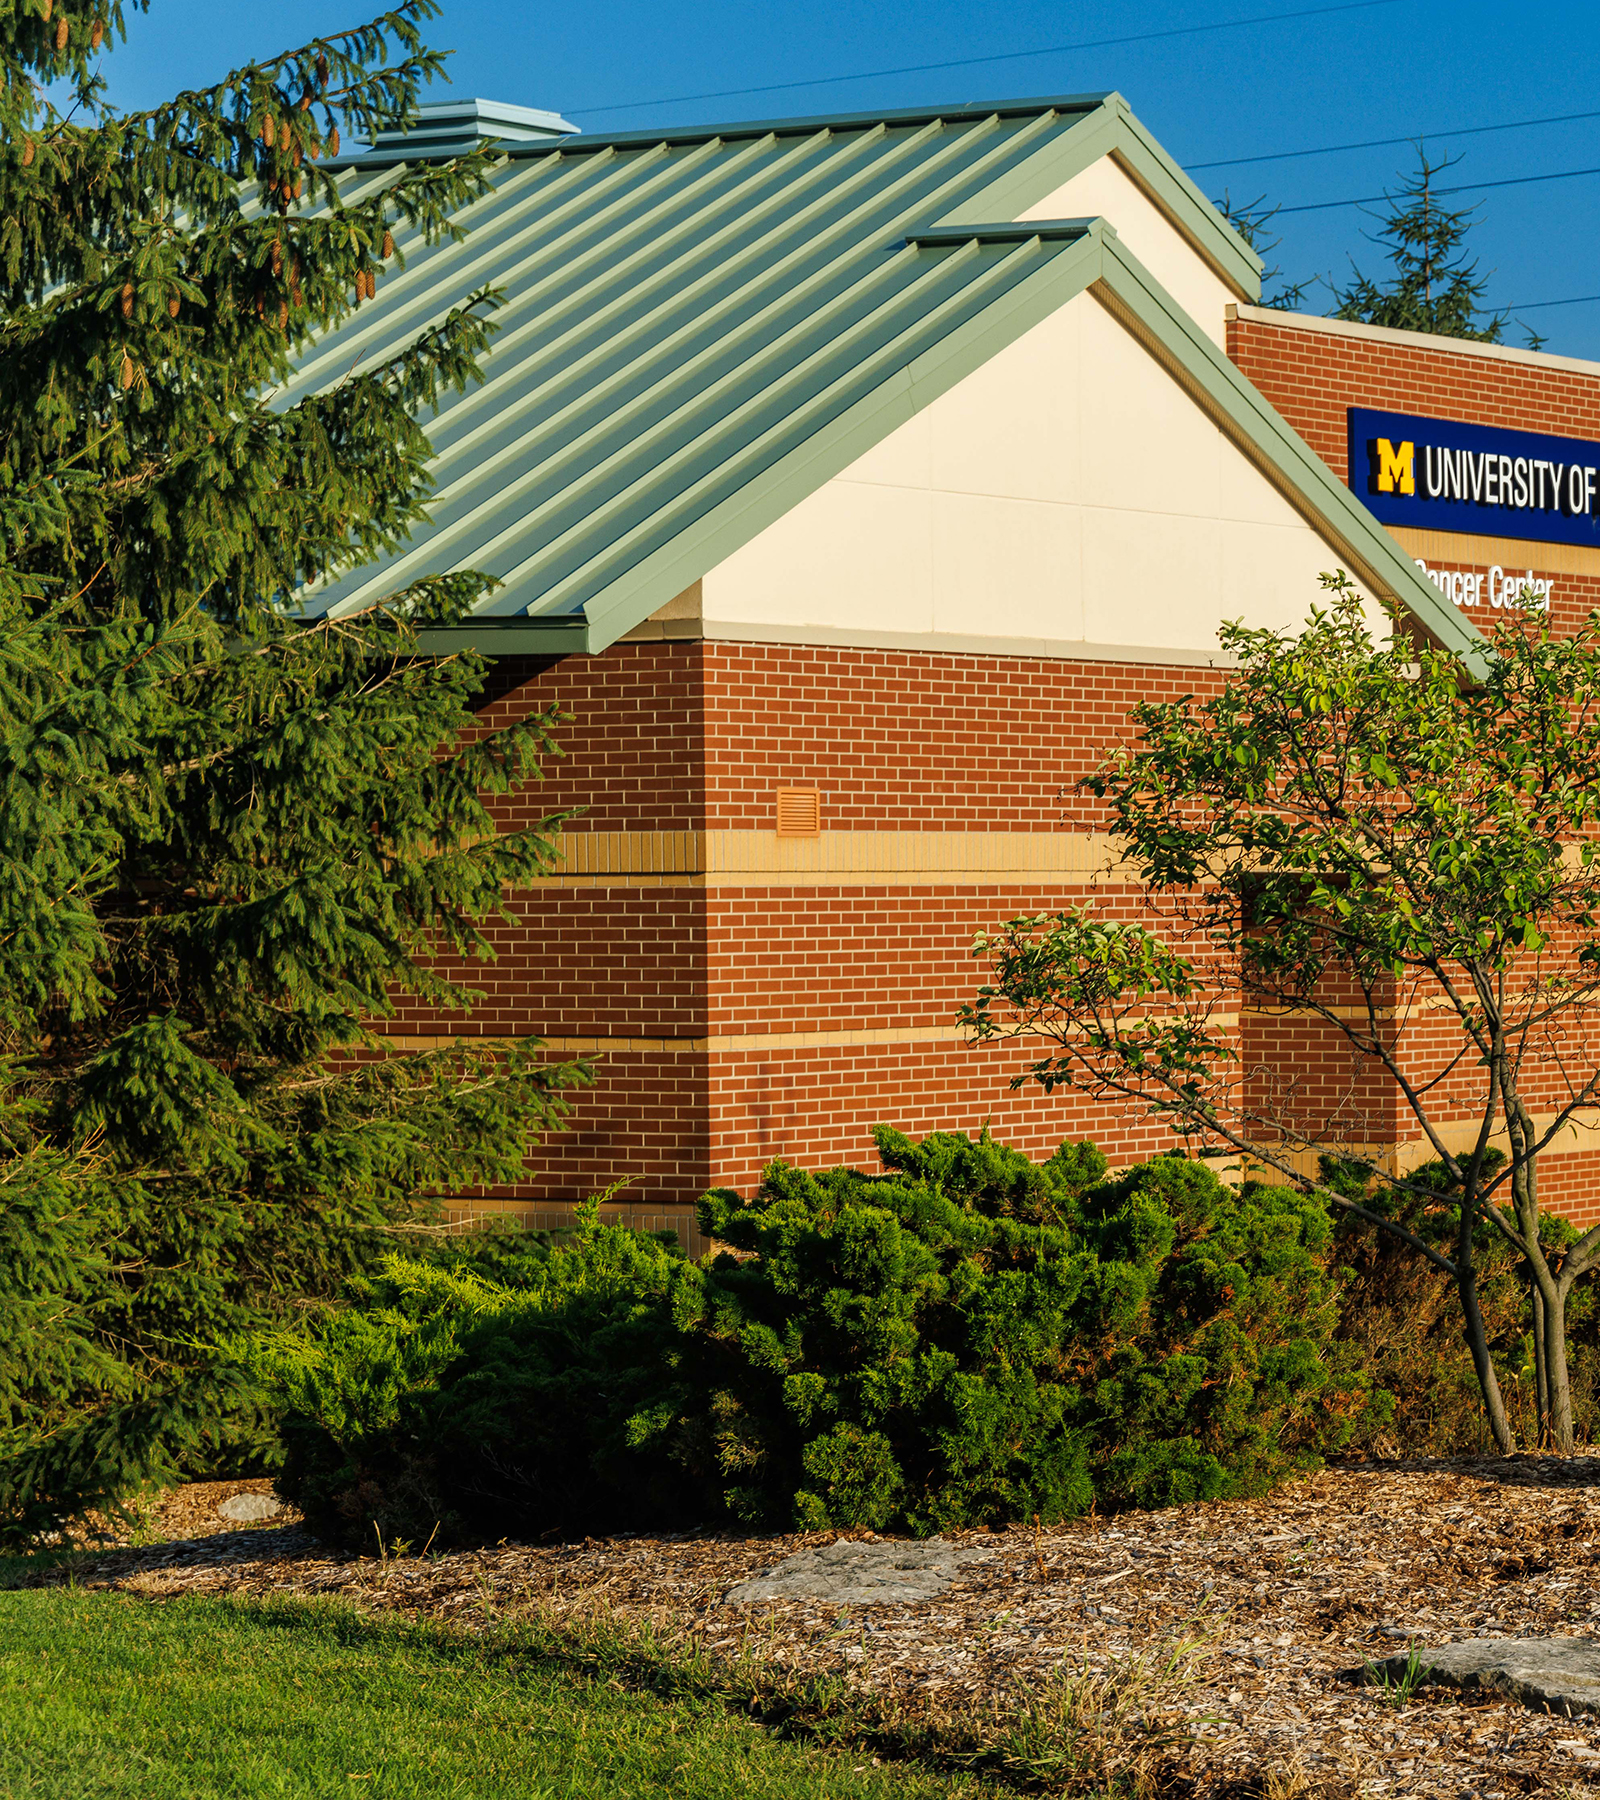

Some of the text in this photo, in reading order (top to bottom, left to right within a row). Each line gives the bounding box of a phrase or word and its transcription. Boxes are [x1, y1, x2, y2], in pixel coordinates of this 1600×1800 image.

[1377, 438, 1415, 495] M
[1426, 445, 1564, 511] UNIVERSITY
[1569, 464, 1597, 515] OF
[1488, 565, 1554, 612] Center
